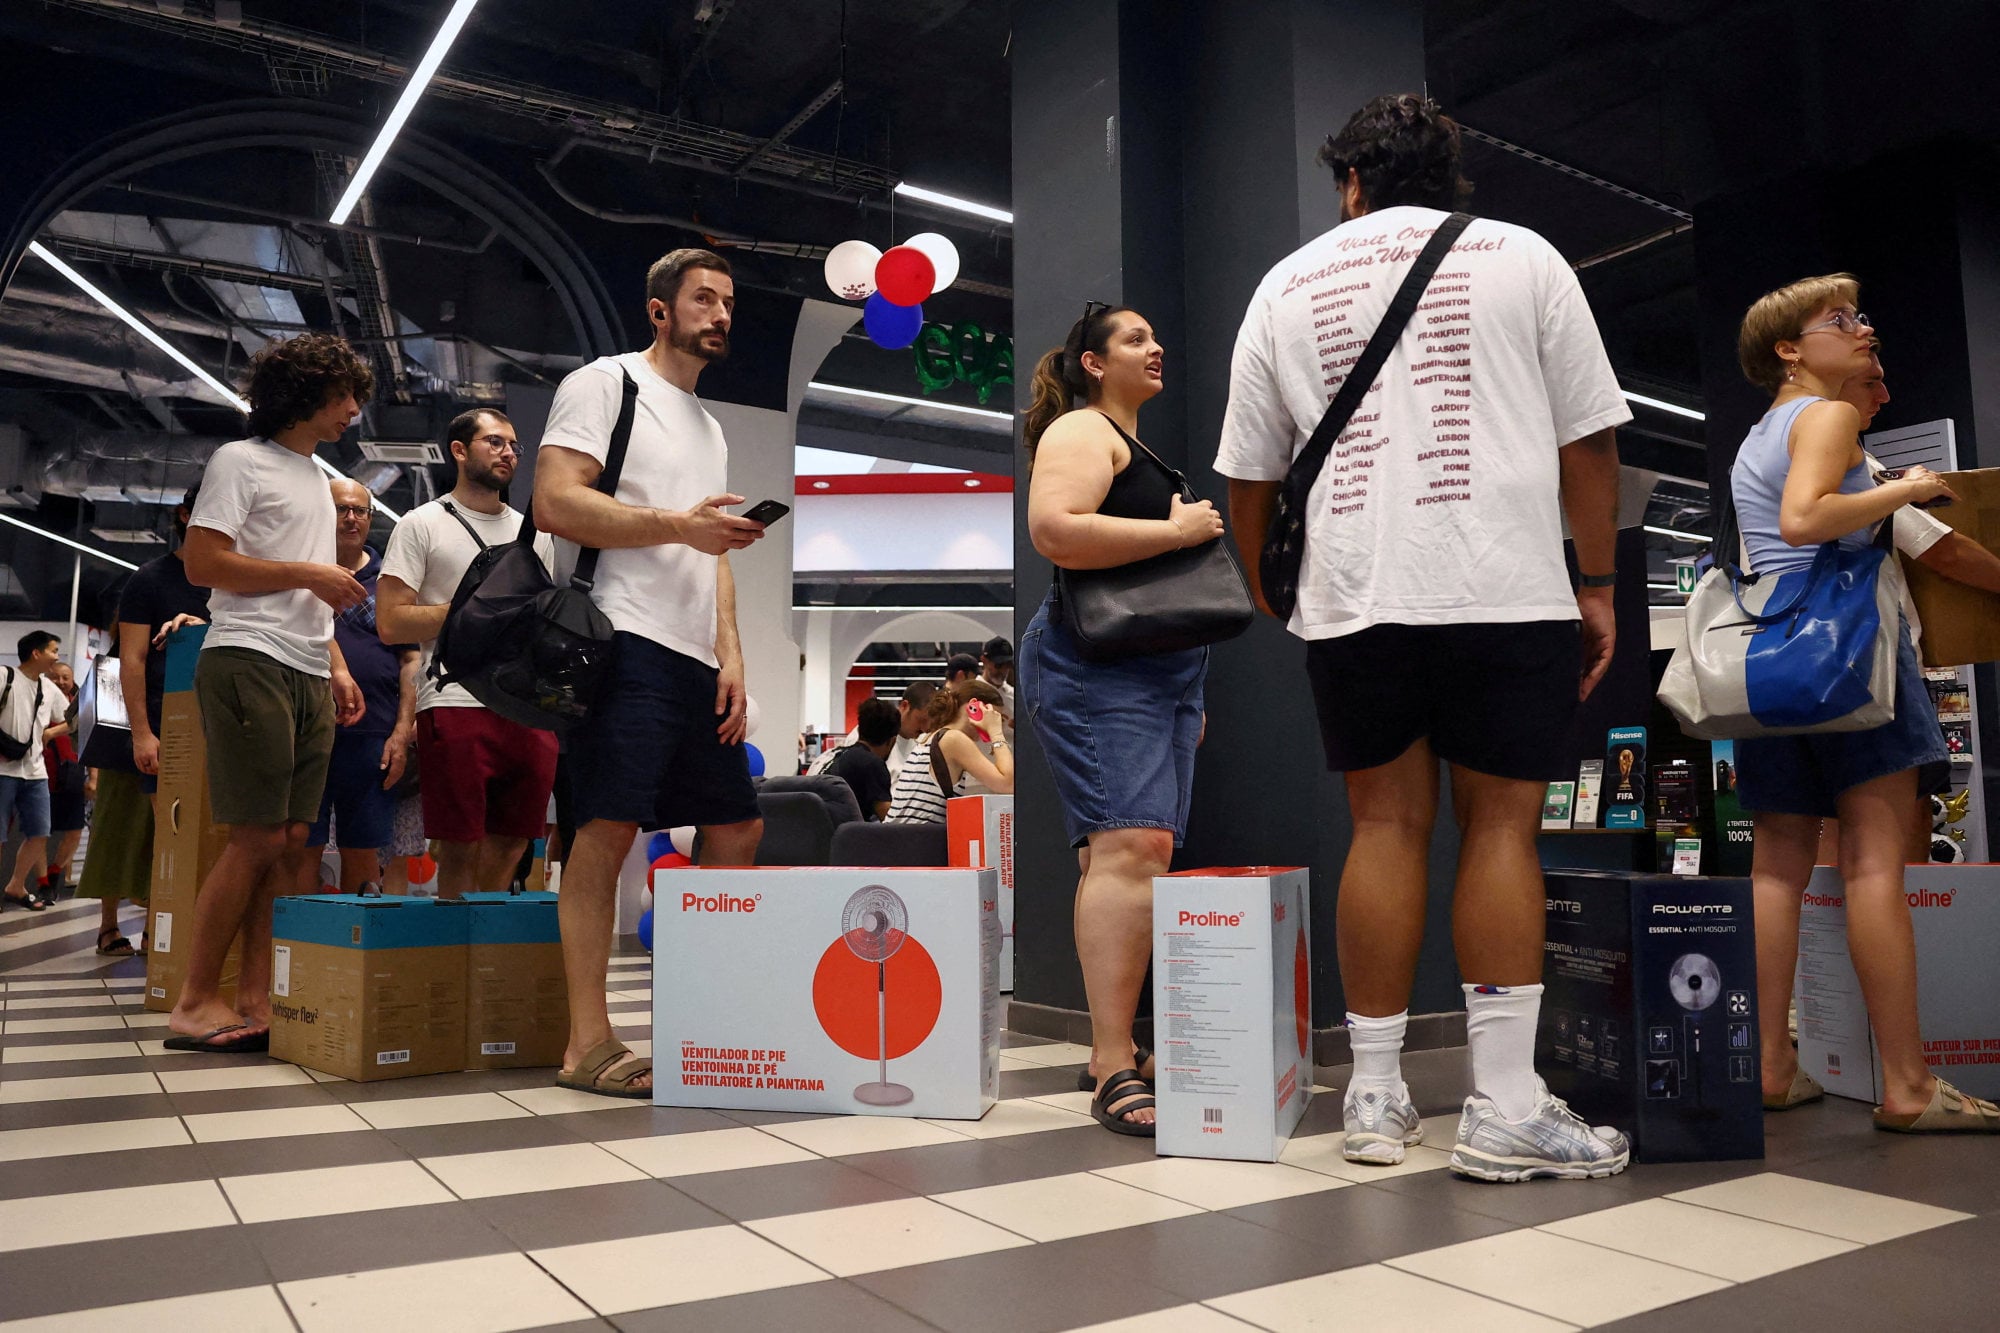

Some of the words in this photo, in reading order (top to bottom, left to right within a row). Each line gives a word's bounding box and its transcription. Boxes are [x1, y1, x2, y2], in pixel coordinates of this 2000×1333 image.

[1336, 232, 1388, 252] Visit
[1396, 226, 1437, 241] Our
[1281, 255, 1375, 297] Locations
[1431, 272, 1471, 281] ORONTO
[1310, 282, 1371, 301] MINNEAPOLIS
[1426, 285, 1471, 296] HERSHEY
[1312, 298, 1353, 315] HOUSTON
[1416, 298, 1470, 312] ASHINGTON
[1314, 313, 1347, 329] DALLAS
[1427, 312, 1471, 324] COLOGNE
[1316, 327, 1354, 343] ATLANTA
[1417, 328, 1471, 341] FRANKFURT
[1318, 339, 1369, 357] CHARLOTTE
[1426, 343, 1471, 354] GLASGOW
[1411, 358, 1471, 372] BIRMINGHAM
[1413, 374, 1471, 386] AMSTERDAM
[1444, 388, 1471, 397] PARIS
[1431, 404, 1471, 413] CARDIFF
[1348, 412, 1380, 426] ANGELE
[1433, 419, 1470, 428] LONDON
[1437, 433, 1470, 442] LISBON
[1335, 450, 1350, 458] SAN
[1417, 448, 1470, 461] BARCELONA
[1334, 464, 1349, 472] LAS
[1443, 463, 1471, 471] ROME
[1429, 478, 1470, 489] WARSAW
[1332, 488, 1367, 501] CHICAGO
[1416, 493, 1471, 506] STOCKHOLM
[1331, 503, 1365, 515] DETROIT
[1611, 732, 1643, 740] Hisense
[1616, 792, 1634, 800] FIFA
[1727, 830, 1753, 842] 100%
[1907, 889, 1952, 908] oline
[1546, 899, 1582, 914] enta
[1704, 925, 1737, 933] MOSQUITO
[1579, 947, 1594, 956] ANTI
[1594, 949, 1627, 963] MOSQUITO
[271, 1001, 299, 1023] whisper
[1924, 1040, 1961, 1052] ILATEUR
[1963, 1039, 1981, 1051] SUR
[681, 1046, 749, 1061] VENTILADOR
[751, 1049, 765, 1061] DE
[768, 1050, 786, 1062] PIE
[681, 1060, 744, 1074] VENTOINHA
[747, 1063, 761, 1075] DE
[681, 1074, 753, 1088] VENTILATORE
[756, 1077, 764, 1089] A
[766, 1078, 825, 1091] PIANTANA
